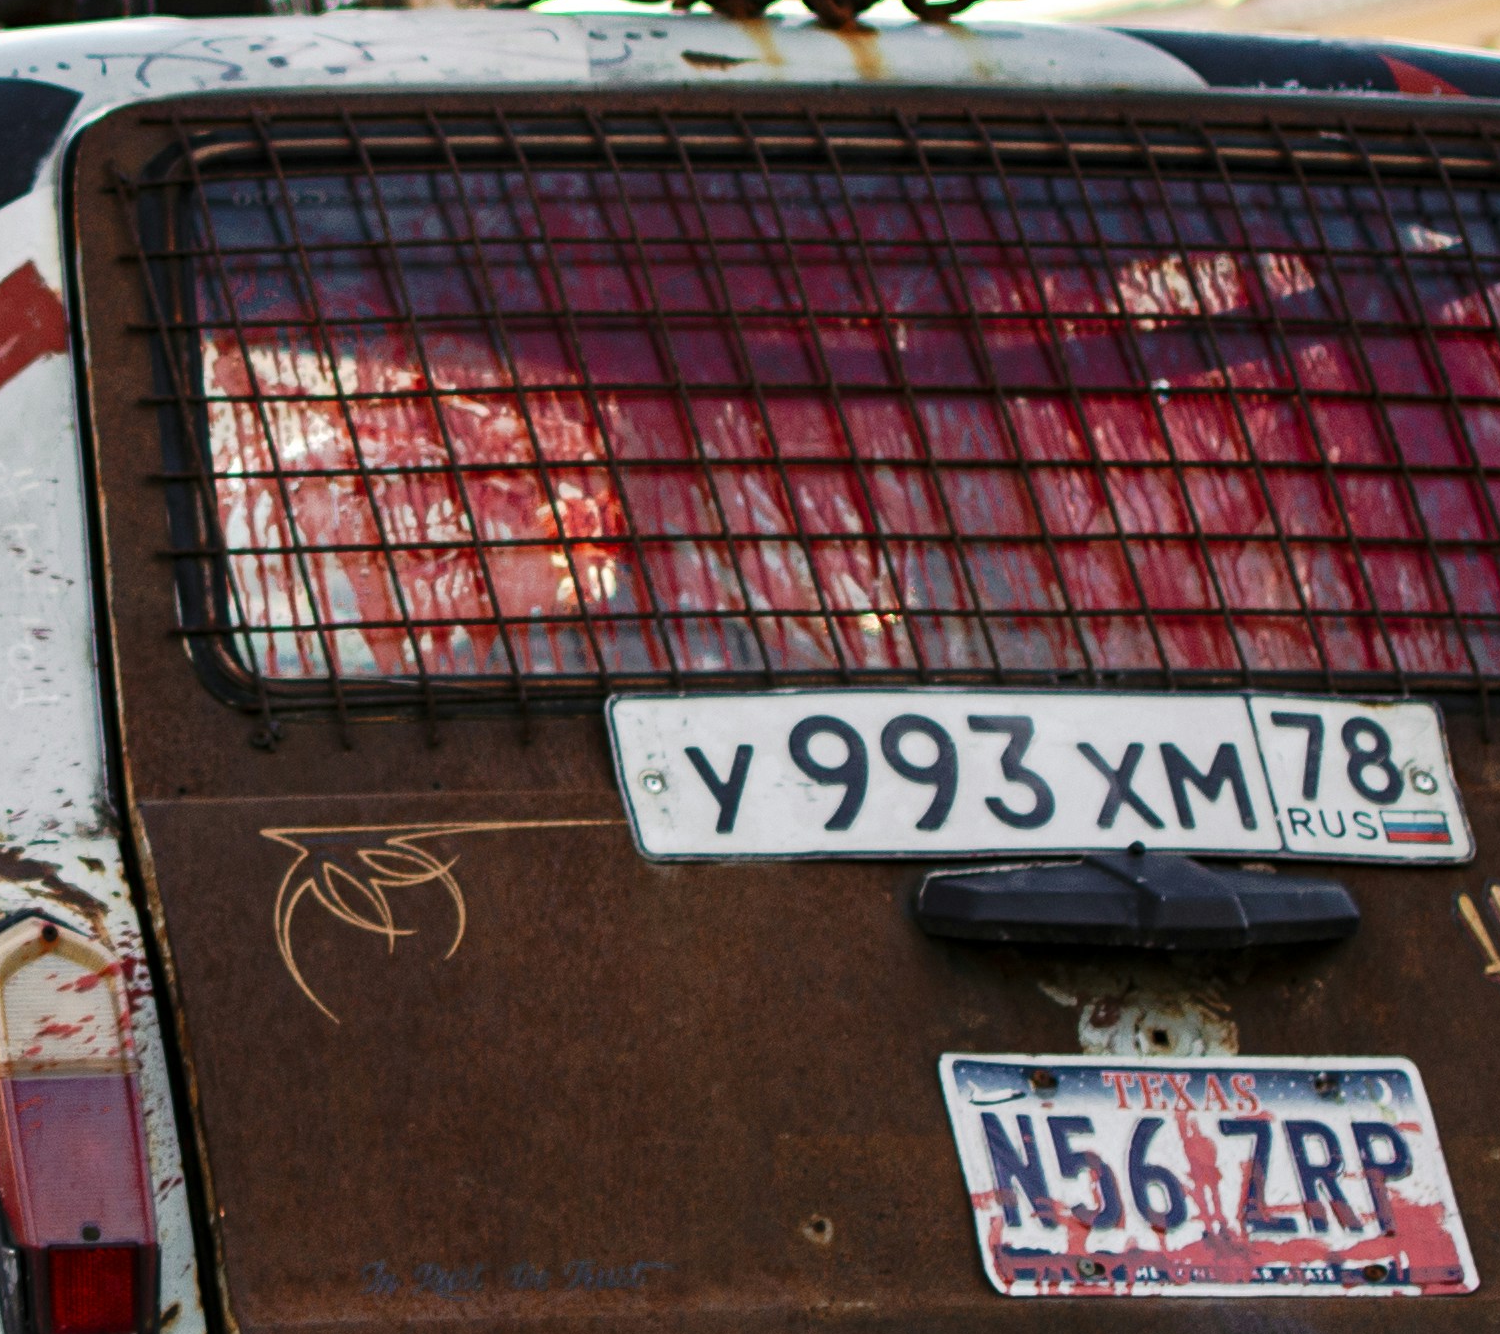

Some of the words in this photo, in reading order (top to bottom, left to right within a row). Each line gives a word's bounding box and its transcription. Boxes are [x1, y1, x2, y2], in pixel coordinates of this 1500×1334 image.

[1270, 710, 1405, 806] 78
[1287, 807, 1379, 841] RUS
[1103, 1072, 1260, 1114] TEXAS
